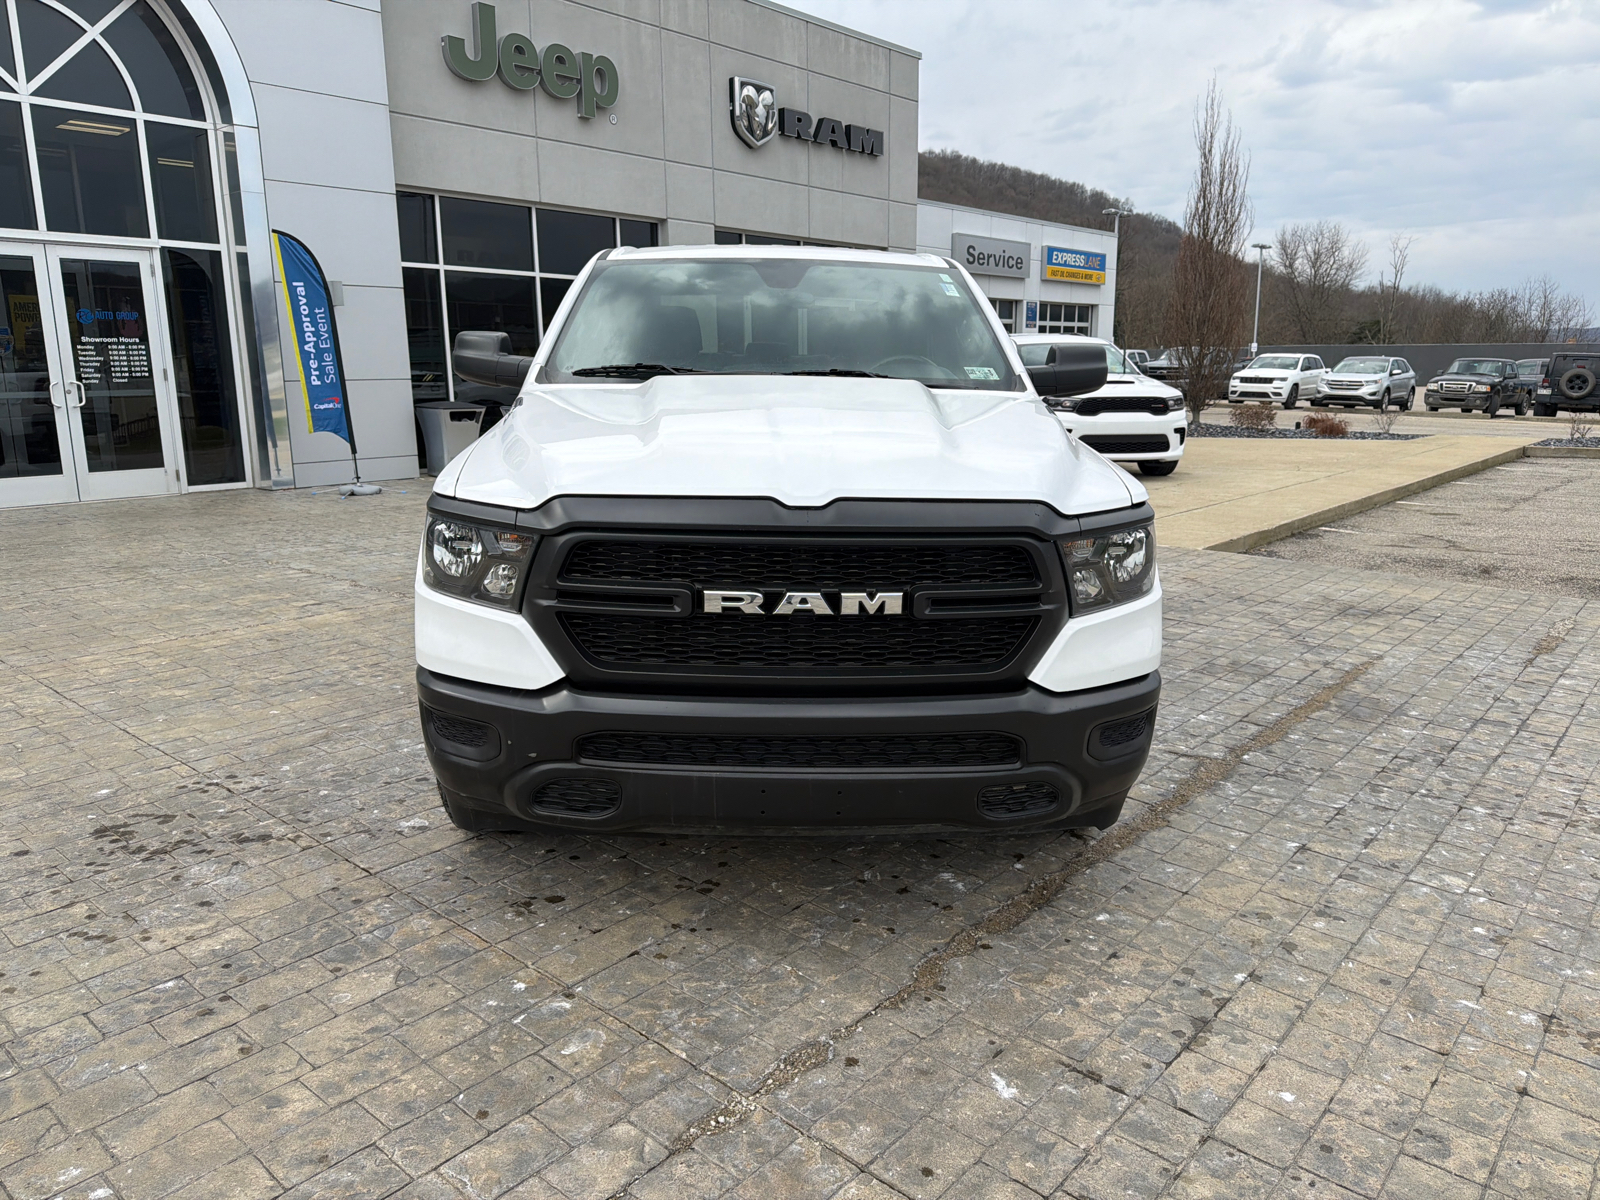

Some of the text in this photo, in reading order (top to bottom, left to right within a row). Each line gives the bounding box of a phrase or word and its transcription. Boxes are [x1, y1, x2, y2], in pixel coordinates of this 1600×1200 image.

[441, 2, 619, 119] Jeep
[778, 107, 884, 157] RAM
[966, 245, 1024, 270] Service
[95, 311, 113, 320] AUTO
[116, 312, 138, 320] GROUP
[292, 282, 321, 386] Pre-Approval
[314, 307, 336, 384] Sale Event
[704, 590, 904, 615] RAM
